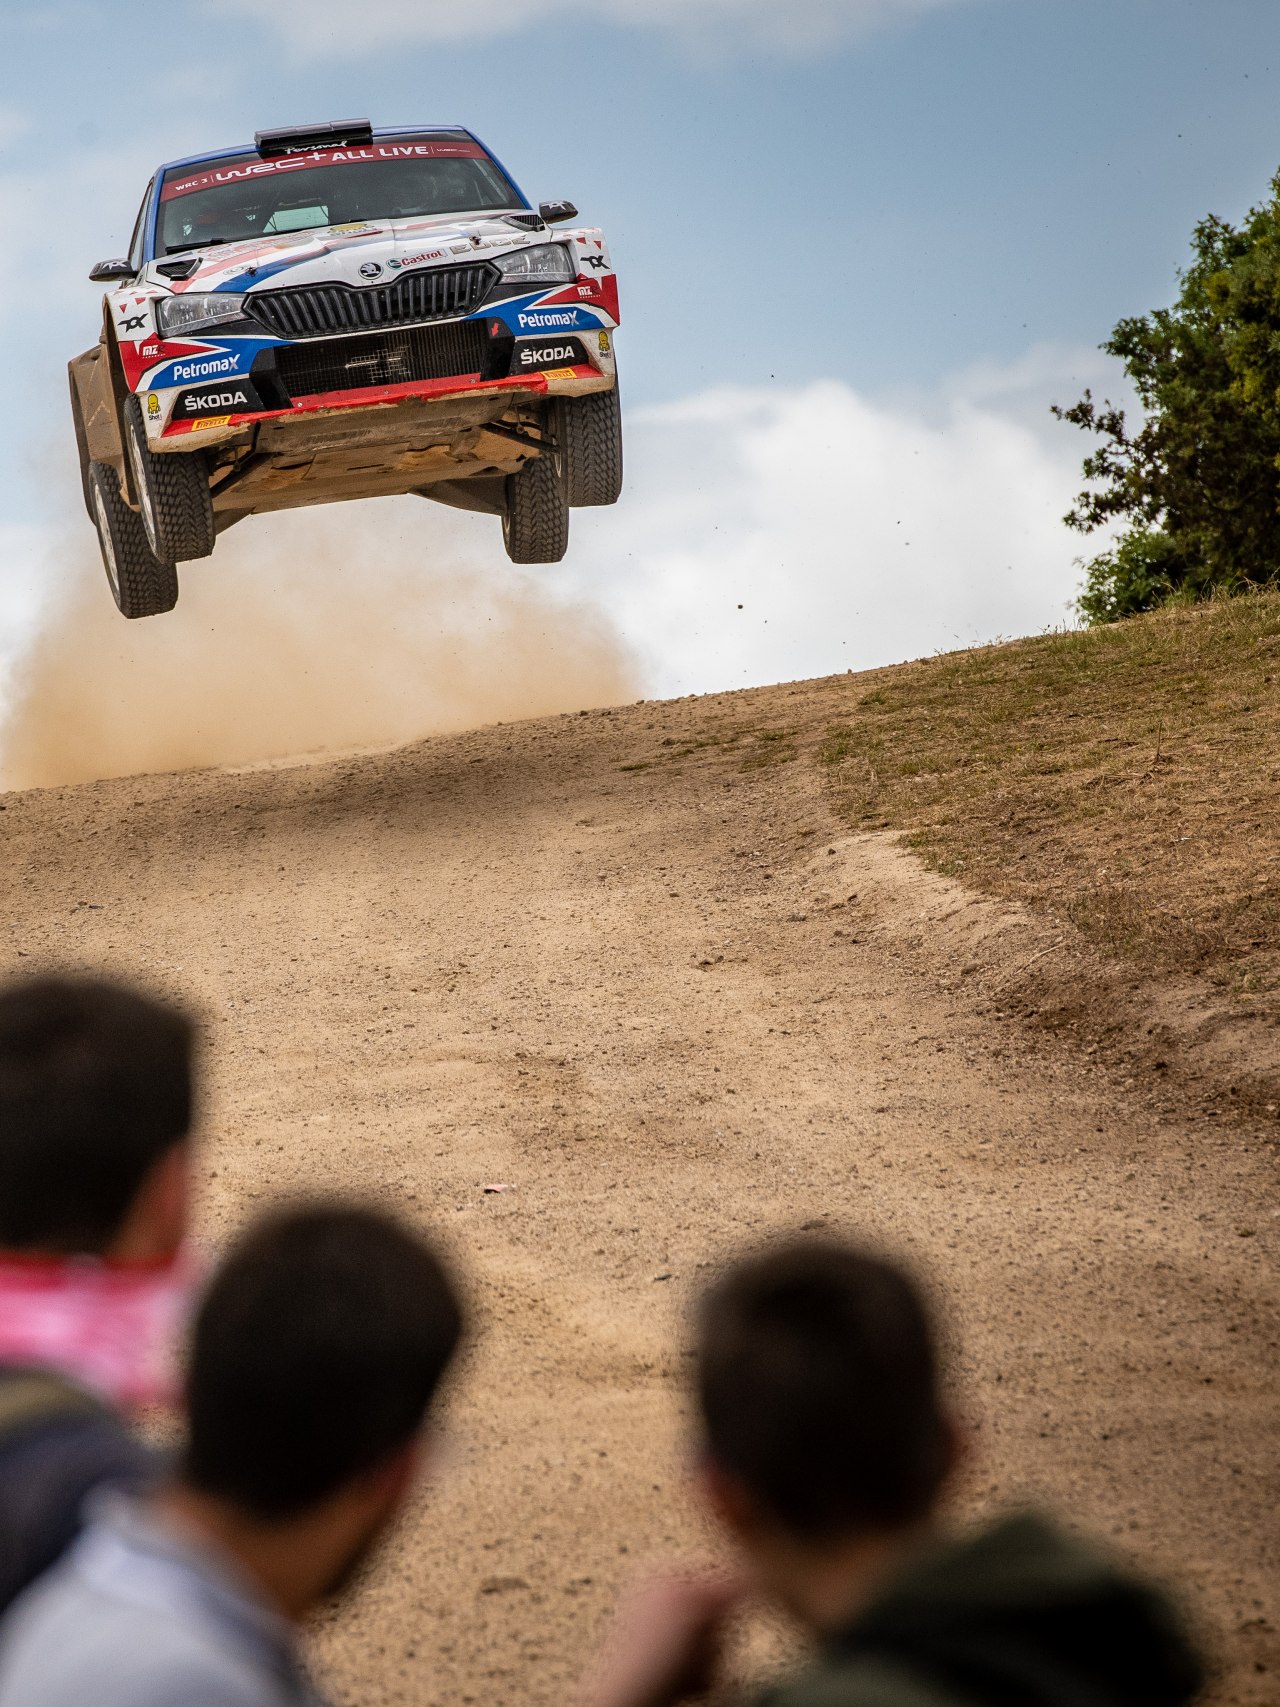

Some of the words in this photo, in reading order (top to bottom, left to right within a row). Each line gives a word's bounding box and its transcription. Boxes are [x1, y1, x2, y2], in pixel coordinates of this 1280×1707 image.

[331, 151, 373, 162] ALL
[379, 146, 429, 157] LIVE
[175, 180, 199, 191] WRC
[401, 250, 443, 266] Castrol
[520, 345, 575, 365] ŠKODA
[184, 392, 248, 411] ŠKODA
